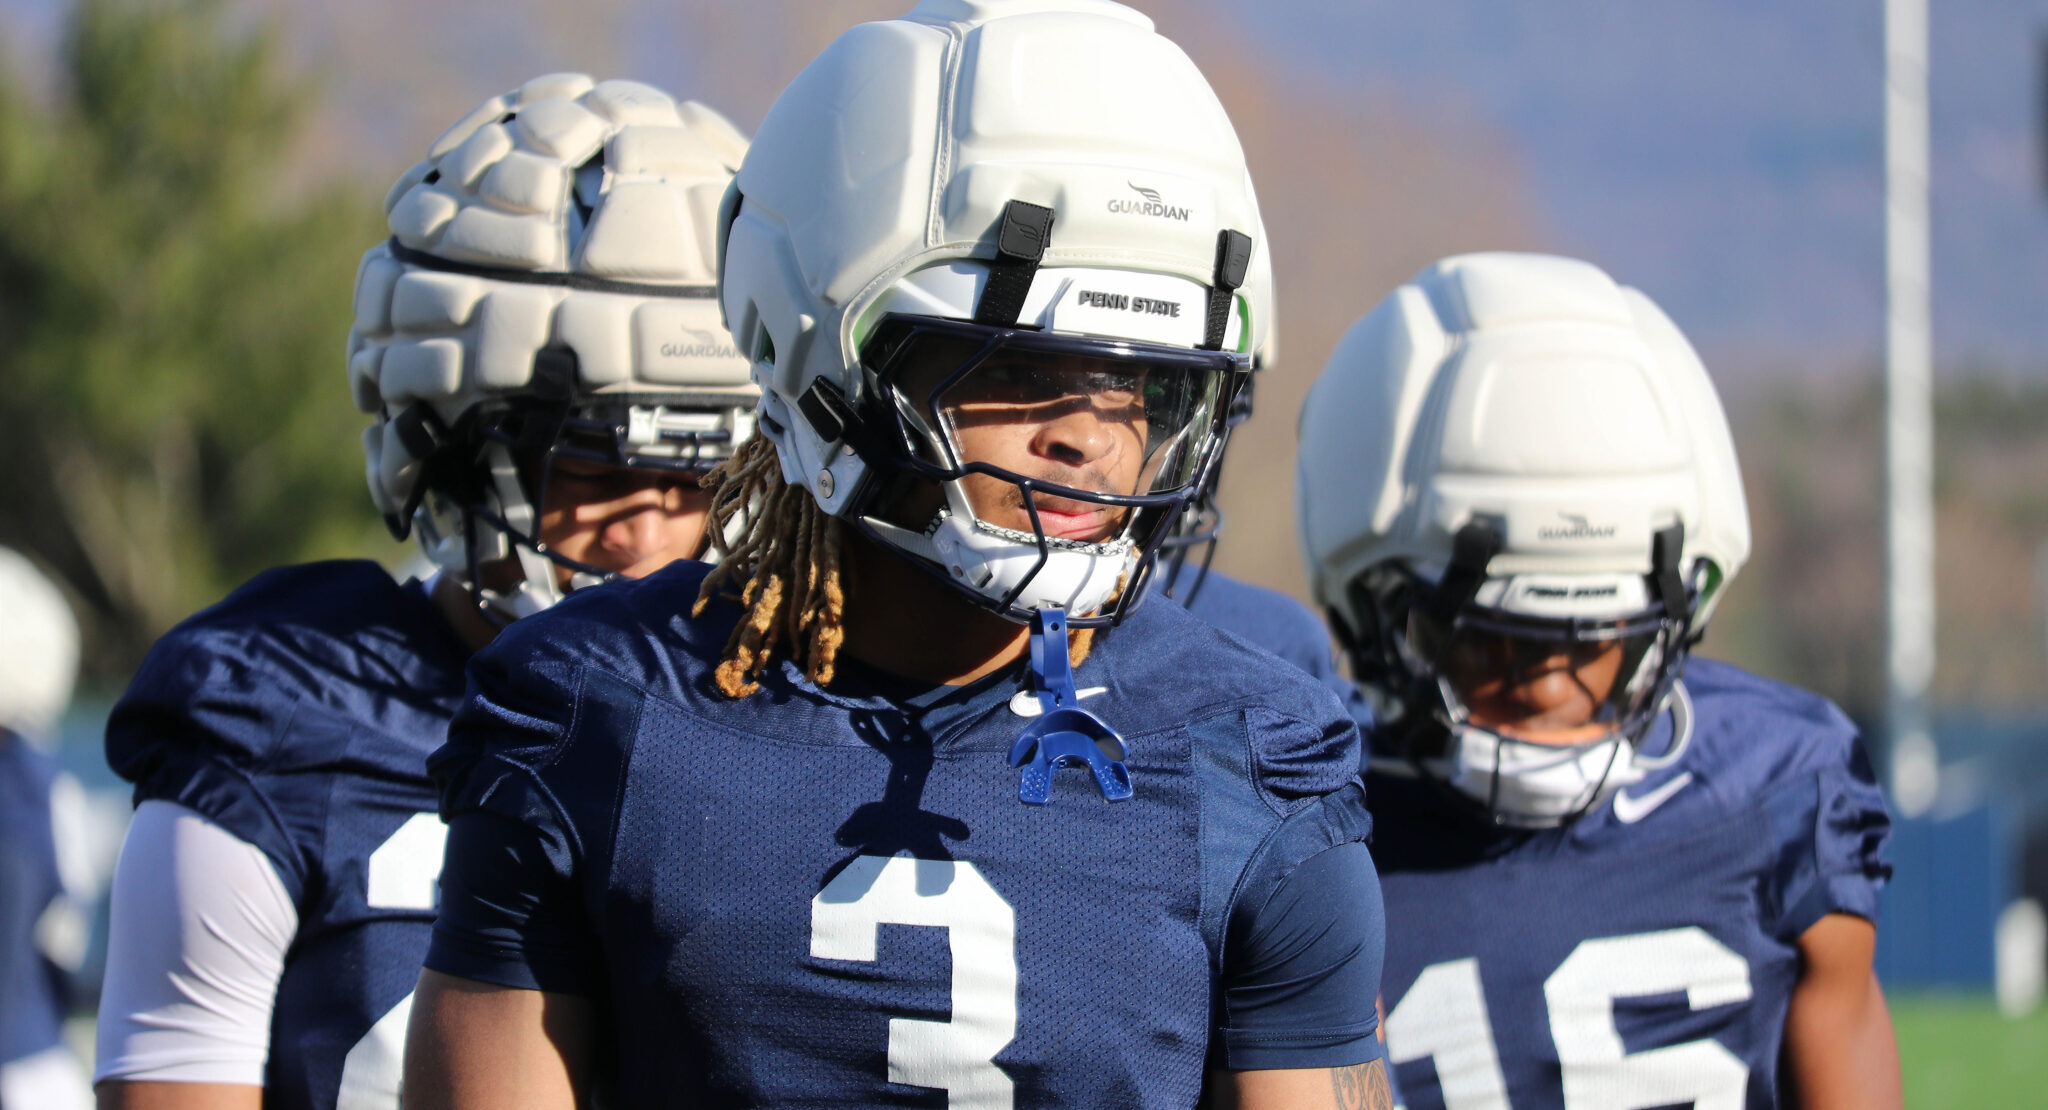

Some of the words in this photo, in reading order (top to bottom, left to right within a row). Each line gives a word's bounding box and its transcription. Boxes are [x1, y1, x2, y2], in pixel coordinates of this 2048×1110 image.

[1107, 199, 1190, 222] GUARDIAN
[1078, 290, 1129, 310] PENN
[1132, 296, 1181, 318] STATE
[810, 856, 1016, 1110] 3
[1386, 927, 1752, 1110] 16
